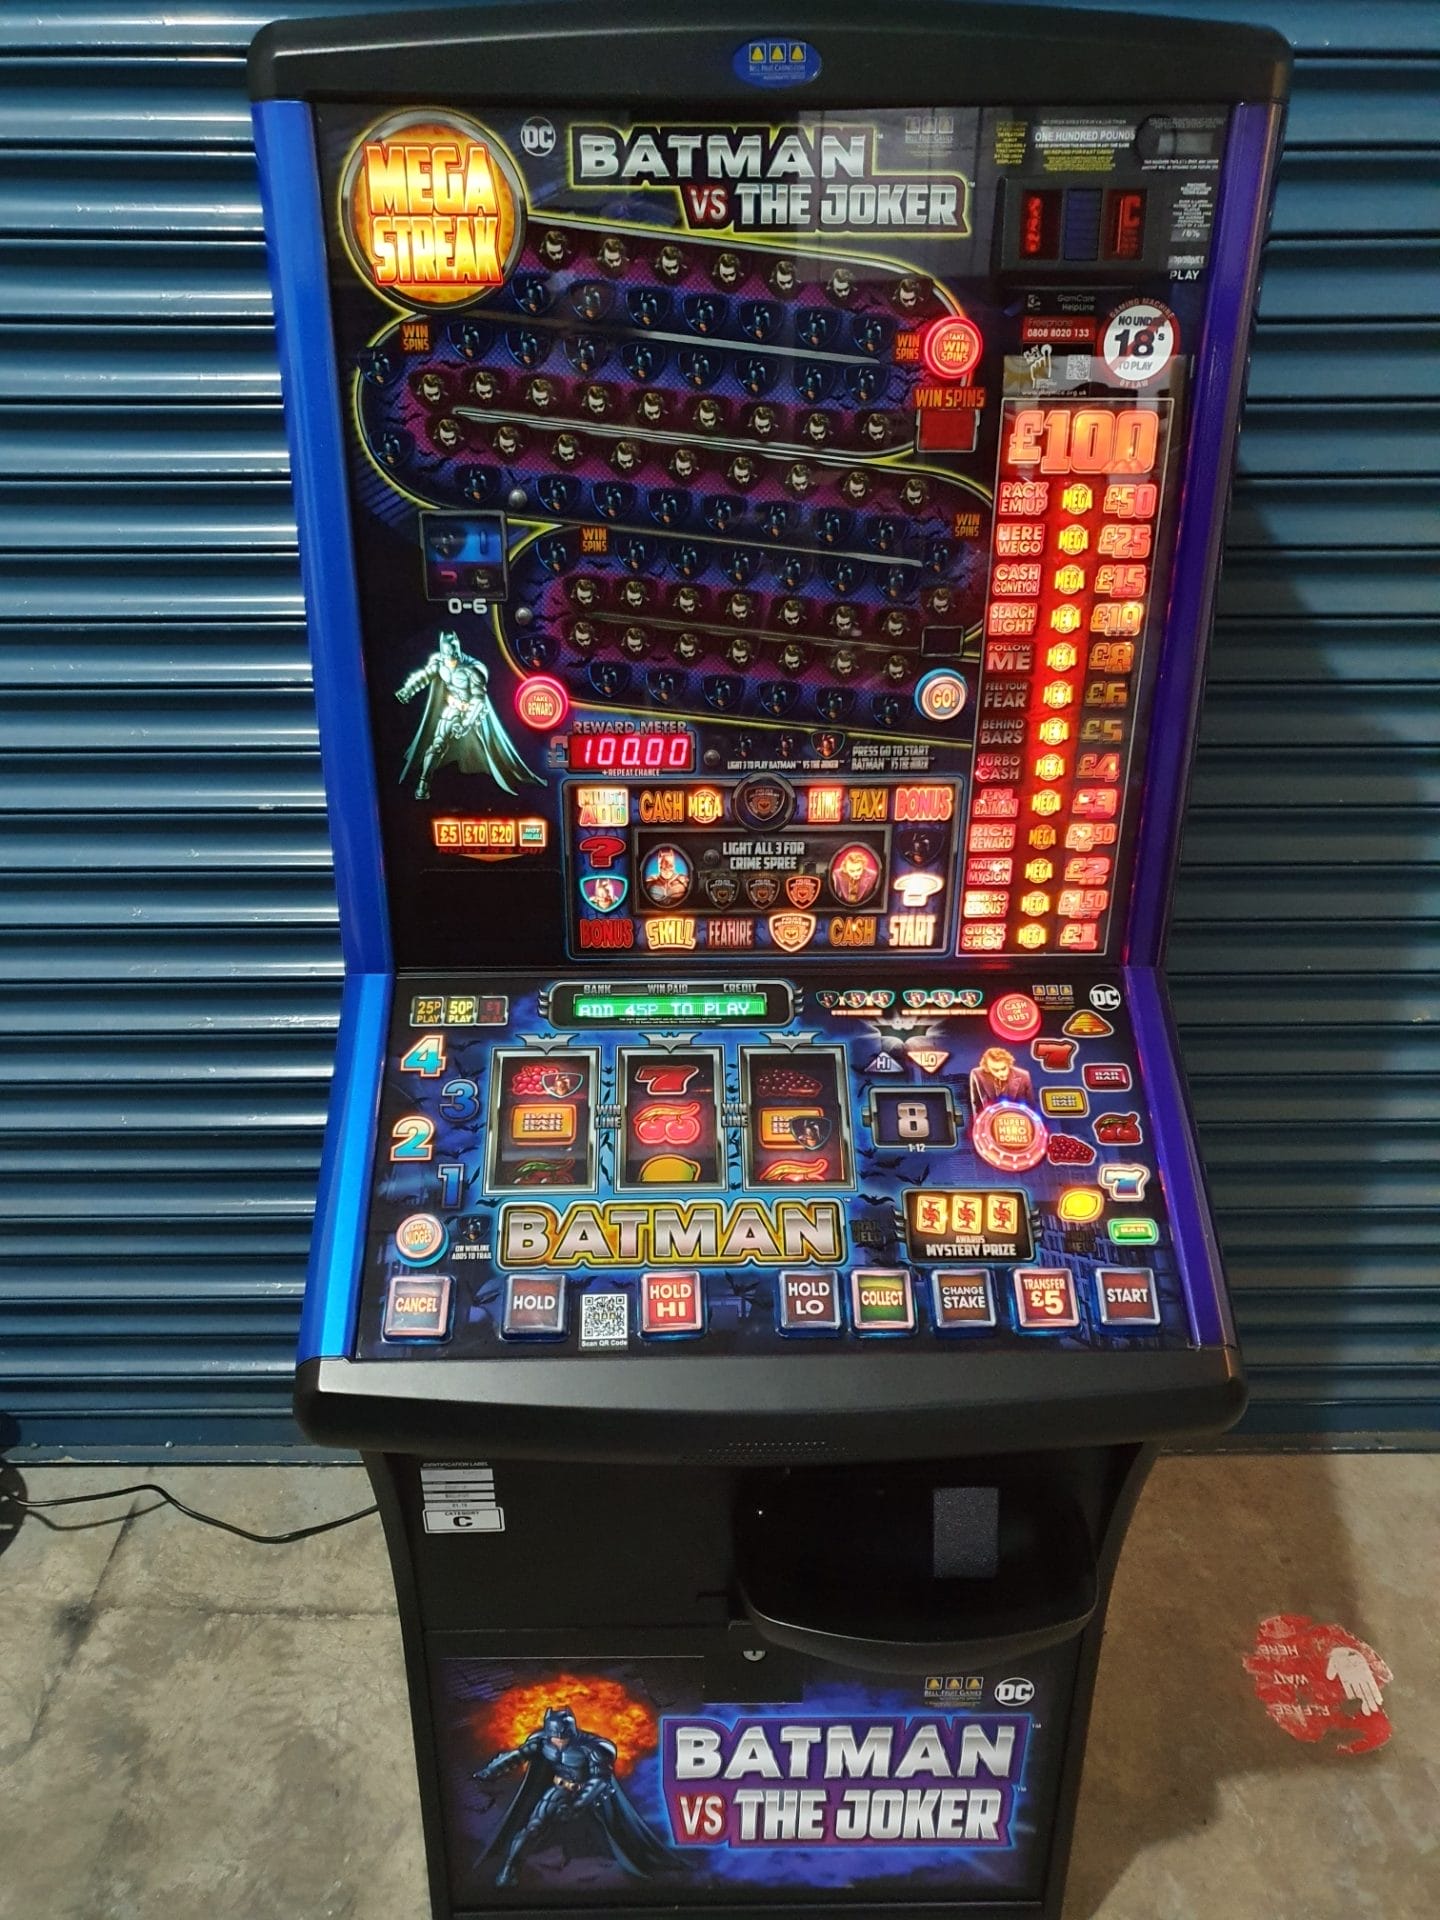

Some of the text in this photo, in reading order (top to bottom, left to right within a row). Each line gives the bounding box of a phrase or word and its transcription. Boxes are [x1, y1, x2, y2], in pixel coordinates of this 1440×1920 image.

[522, 128, 555, 151] DC
[1035, 129, 1136, 142] ONE HUNDRED POUNDS
[580, 134, 866, 178] BATMAN
[364, 143, 498, 217] MEGA
[689, 184, 959, 227] VS THE JOKER
[372, 216, 503, 285] STREAK
[1170, 269, 1200, 281] PLAY
[1057, 294, 1096, 303] GamCare
[1062, 303, 1095, 312] HelpLine
[1109, 297, 1175, 319] GAMING MACHINE
[1028, 319, 1073, 329] Freephone
[1118, 315, 1132, 326] NO
[402, 325, 428, 338] WIN
[1027, 329, 1090, 338] 0808 8020 133
[403, 338, 429, 350] SPINS
[897, 334, 920, 348] WIN
[942, 341, 970, 351] WIN
[895, 347, 919, 361] SPINS
[941, 350, 970, 363] SPINS
[1131, 361, 1152, 371] PLAY
[1119, 379, 1149, 389] BY LAW
[915, 389, 985, 408] WIN SPINS
[1008, 410, 1159, 474] £100
[1001, 483, 1048, 499] RACK
[1024, 498, 1048, 515] UP
[1103, 484, 1157, 518] £50
[956, 513, 980, 526] WIN
[582, 527, 606, 540] WIN
[955, 525, 980, 538] SPINS
[998, 525, 1044, 541] HERE
[582, 540, 607, 552] SPINS
[1098, 525, 1151, 558] £25
[995, 565, 1040, 581] CASH
[1095, 565, 1146, 597] £15
[993, 580, 1039, 595] CONVEYOR
[448, 598, 488, 614] 0-6
[990, 603, 1036, 619] SEARCH
[988, 618, 1035, 635] LIGHT
[1090, 603, 1143, 636] £10
[989, 643, 1032, 651] FOLLOW
[986, 651, 1032, 671] ME
[932, 690, 956, 709] GO!
[984, 692, 1026, 709] FEAR
[1085, 681, 1128, 706] £6
[528, 701, 553, 716] REWARD
[572, 720, 688, 735] REWARD METER
[982, 719, 1024, 731] BEHIND
[1082, 720, 1123, 743] £5
[981, 730, 1024, 745] BARS
[584, 737, 689, 766] 100.00
[852, 744, 929, 756] PRESS START
[978, 756, 1021, 767] TURBO
[1078, 754, 1120, 782] £4
[634, 769, 661, 777] CHANCE
[976, 767, 1020, 781] CASH
[639, 790, 685, 823] CASH
[688, 795, 723, 818] MEGA
[808, 788, 842, 822] FEATURE
[850, 788, 889, 821] TAXI
[894, 786, 953, 821] BONUS
[973, 799, 1018, 817] BATMAN
[1072, 788, 1117, 816] £3
[440, 825, 457, 843] £5
[465, 825, 486, 843] £10
[491, 825, 512, 843] £20
[970, 824, 1016, 838] RICH
[1028, 829, 1057, 845] MEGA
[1065, 823, 1116, 851] £2.50
[722, 842, 805, 855] LIGHT ALL FOR
[969, 837, 1014, 852] REWARD
[730, 857, 797, 870] CRIME SPREE
[969, 859, 992, 871] WAIT
[1064, 857, 1110, 884] £2
[968, 871, 1011, 884] MY SIGN
[1058, 890, 1108, 917] £1.50
[579, 918, 633, 948] BONUS
[645, 917, 697, 950] SKILL
[708, 920, 753, 947] FEATURE
[829, 916, 877, 946] CASH
[888, 915, 936, 946] START
[964, 924, 1006, 937] QUICK
[1059, 923, 1097, 949] £1
[961, 935, 1005, 949] SHOT
[583, 984, 611, 995] BANK
[723, 983, 757, 994] CREDIT
[1090, 987, 1120, 1007] DC
[579, 1002, 750, 1017] ADD 45P TO PLAY
[416, 1014, 440, 1024] PLAY
[448, 1014, 472, 1024] PLAY
[400, 1034, 447, 1077] 4
[876, 1056, 891, 1070] HI
[919, 1053, 938, 1067] LO
[439, 1079, 480, 1122] 3
[596, 1104, 622, 1116] WIN
[722, 1103, 748, 1115] WIN
[594, 1116, 623, 1129] LINE
[721, 1115, 749, 1128] LINE
[897, 1103, 930, 1138] 8
[389, 1115, 435, 1161] 2
[1000, 1126, 1027, 1136] HERO
[438, 1164, 465, 1208] 1
[506, 1207, 836, 1260] BATMAN
[926, 1243, 1017, 1256] MYSTERY PRIZE
[650, 1283, 692, 1300] HOLD
[788, 1281, 831, 1297] HOLD
[942, 1285, 985, 1296] CHANGE
[1024, 1278, 1066, 1291] TRANSFER
[513, 1295, 556, 1311] HOLD
[861, 1289, 904, 1307] COLLECT
[943, 1296, 987, 1310] STAKE
[1031, 1290, 1064, 1315] £5
[1106, 1287, 1149, 1304] START
[395, 1297, 438, 1313] CANCEL
[657, 1302, 686, 1317] HI
[796, 1300, 825, 1315] LO
[452, 1516, 473, 1527] C
[1273, 1670, 1309, 1687] WAIT
[995, 1682, 1035, 1703] DC
[675, 1724, 1016, 1780] BATMAN
[680, 1788, 1003, 1841] VS THE JOKER
